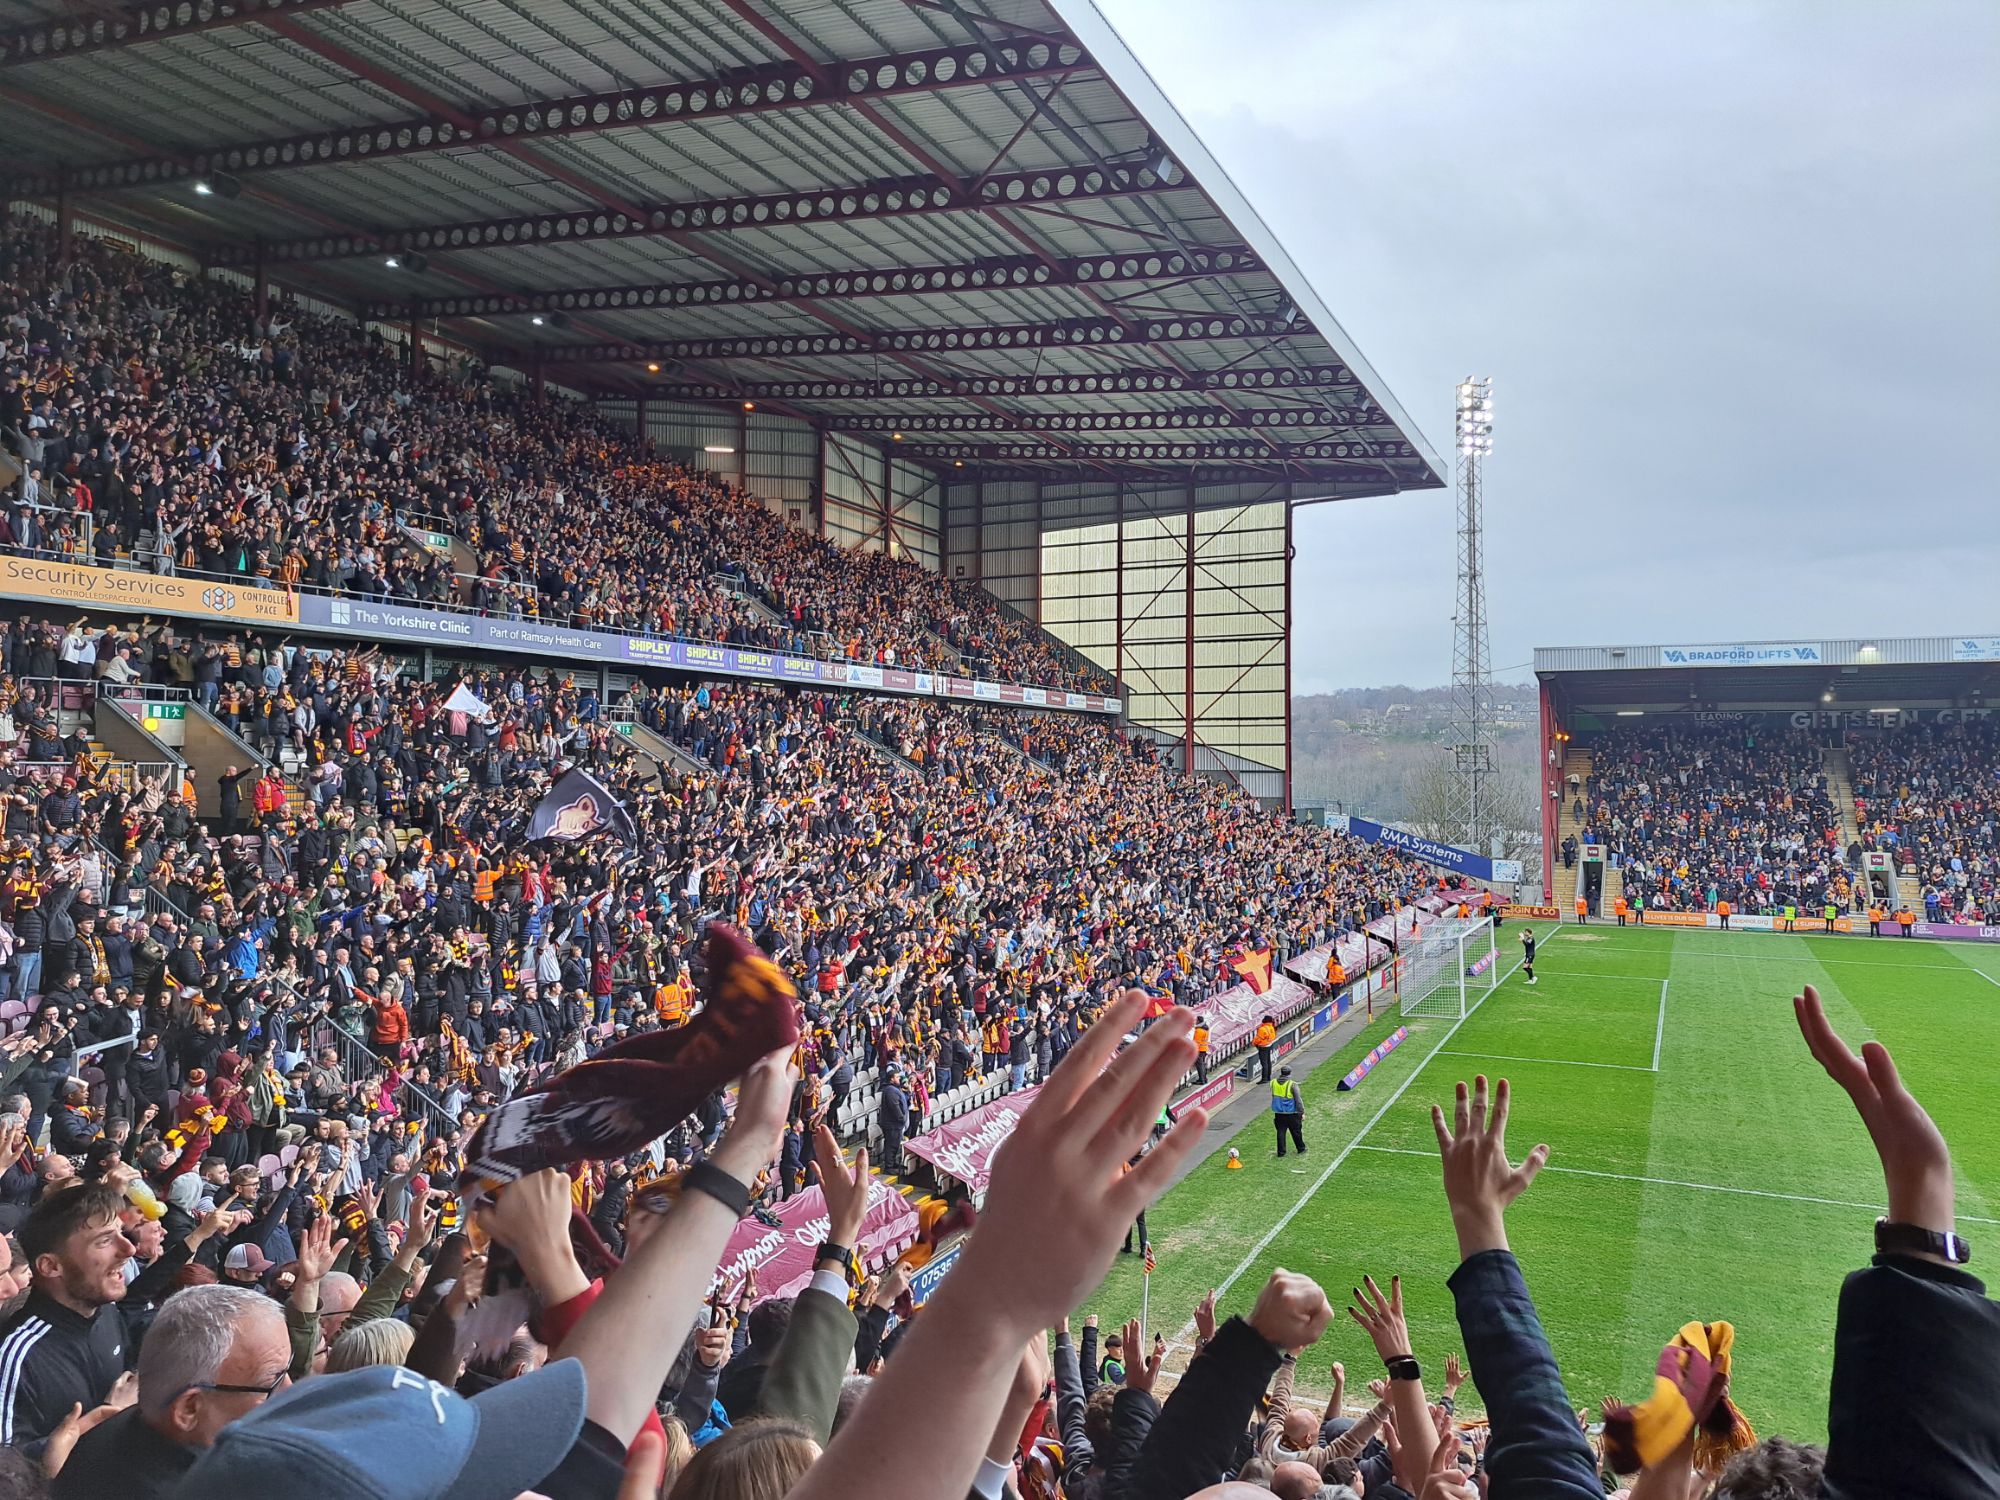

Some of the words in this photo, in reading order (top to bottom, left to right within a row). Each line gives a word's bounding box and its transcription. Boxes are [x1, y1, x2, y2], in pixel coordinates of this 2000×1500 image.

[7, 561, 98, 591] Security
[104, 573, 186, 598] Services
[50, 587, 153, 605] CONTROLLEDSPACE.CO.UK
[255, 604, 278, 615] SPACE
[354, 609, 379, 624] The
[382, 612, 437, 631] Yorkshire
[440, 618, 471, 635] Clinic
[490, 626, 508, 639] Part
[510, 628, 520, 640] of
[521, 630, 554, 646] Ramsay
[555, 634, 582, 647] Health
[583, 637, 602, 649] Care
[629, 639, 672, 655] SHIPLEY
[686, 646, 725, 661] SHIPLEY
[1689, 650, 1754, 660] BRADFORD
[1758, 649, 1791, 659] LIFTS
[737, 653, 773, 667] SHIPLEY
[784, 659, 815, 672] SHIPLEY
[821, 664, 833, 679] THE
[834, 666, 847, 680] KOP
[1694, 712, 1743, 720] LEADING
[1380, 827, 1410, 847] RMA
[1411, 837, 1463, 863] Systems
[1541, 908, 1556, 916] CO
[794, 1211, 832, 1249] Offic
[921, 1257, 952, 1289] 07535
